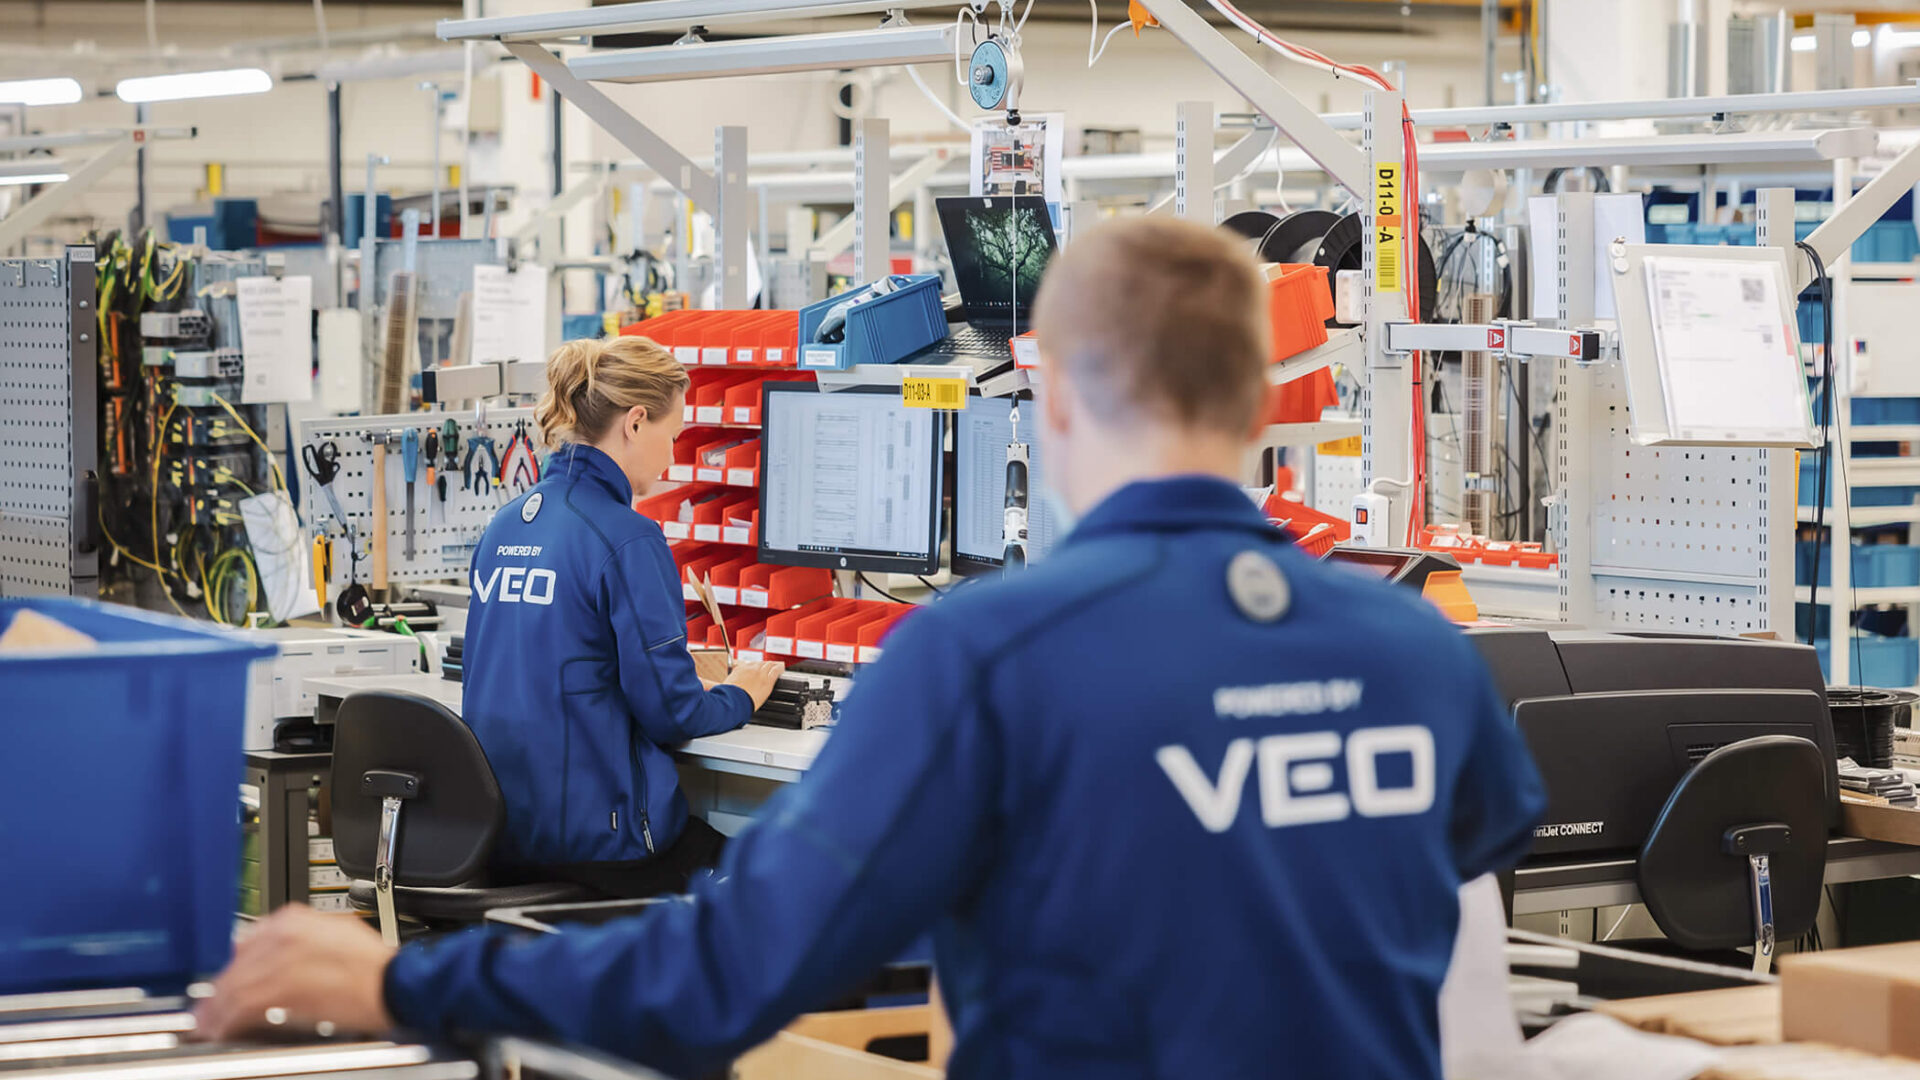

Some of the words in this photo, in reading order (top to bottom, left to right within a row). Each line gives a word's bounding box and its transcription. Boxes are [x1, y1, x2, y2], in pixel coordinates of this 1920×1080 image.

[1378, 168, 1395, 244] D11-0-A
[903, 382, 931, 401] D11-03-A
[496, 545, 531, 556] POWERED
[531, 546, 543, 557] BY
[474, 566, 557, 606] VEO
[1213, 681, 1324, 719] POWERED
[1325, 677, 1363, 713] BY
[1155, 723, 1437, 834] VEO
[1532, 824, 1559, 838] rintJet
[1560, 821, 1604, 836] CONNECT
